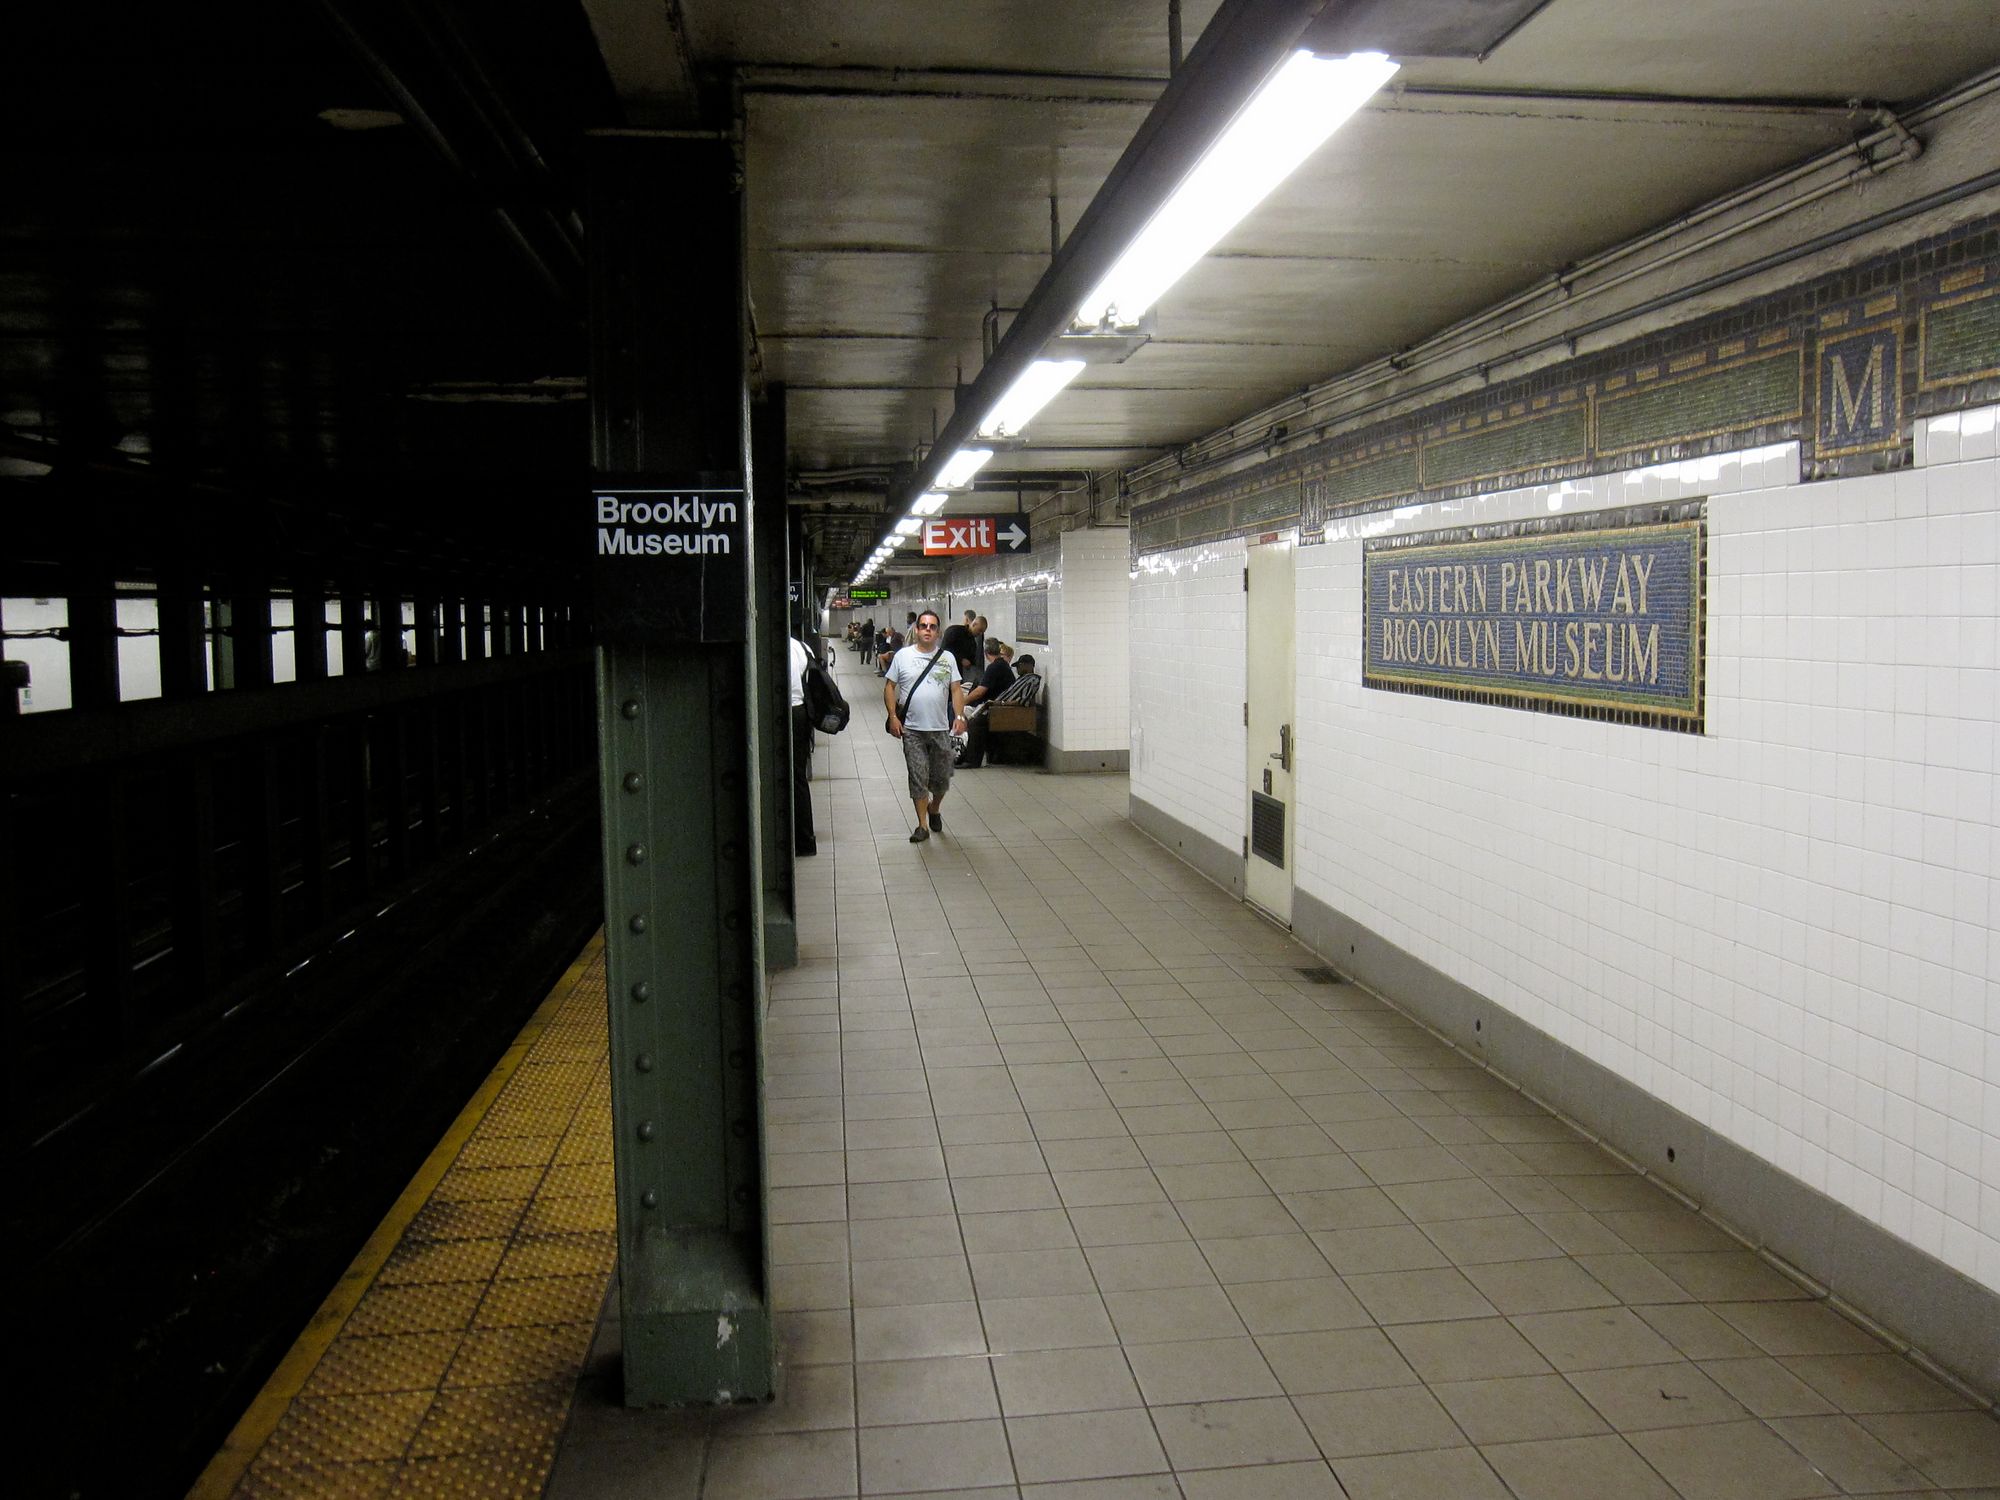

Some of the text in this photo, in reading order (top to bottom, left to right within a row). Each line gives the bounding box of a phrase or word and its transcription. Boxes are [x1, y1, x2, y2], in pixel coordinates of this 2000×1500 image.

[1829, 344, 1884, 437] M
[597, 496, 737, 529] Brooklyn
[926, 520, 991, 549] Exit
[598, 528, 730, 556] Museum
[1388, 553, 1655, 615] EASTERN PARKWAY
[1382, 617, 1660, 685] BROOKLYN MUSEUM
